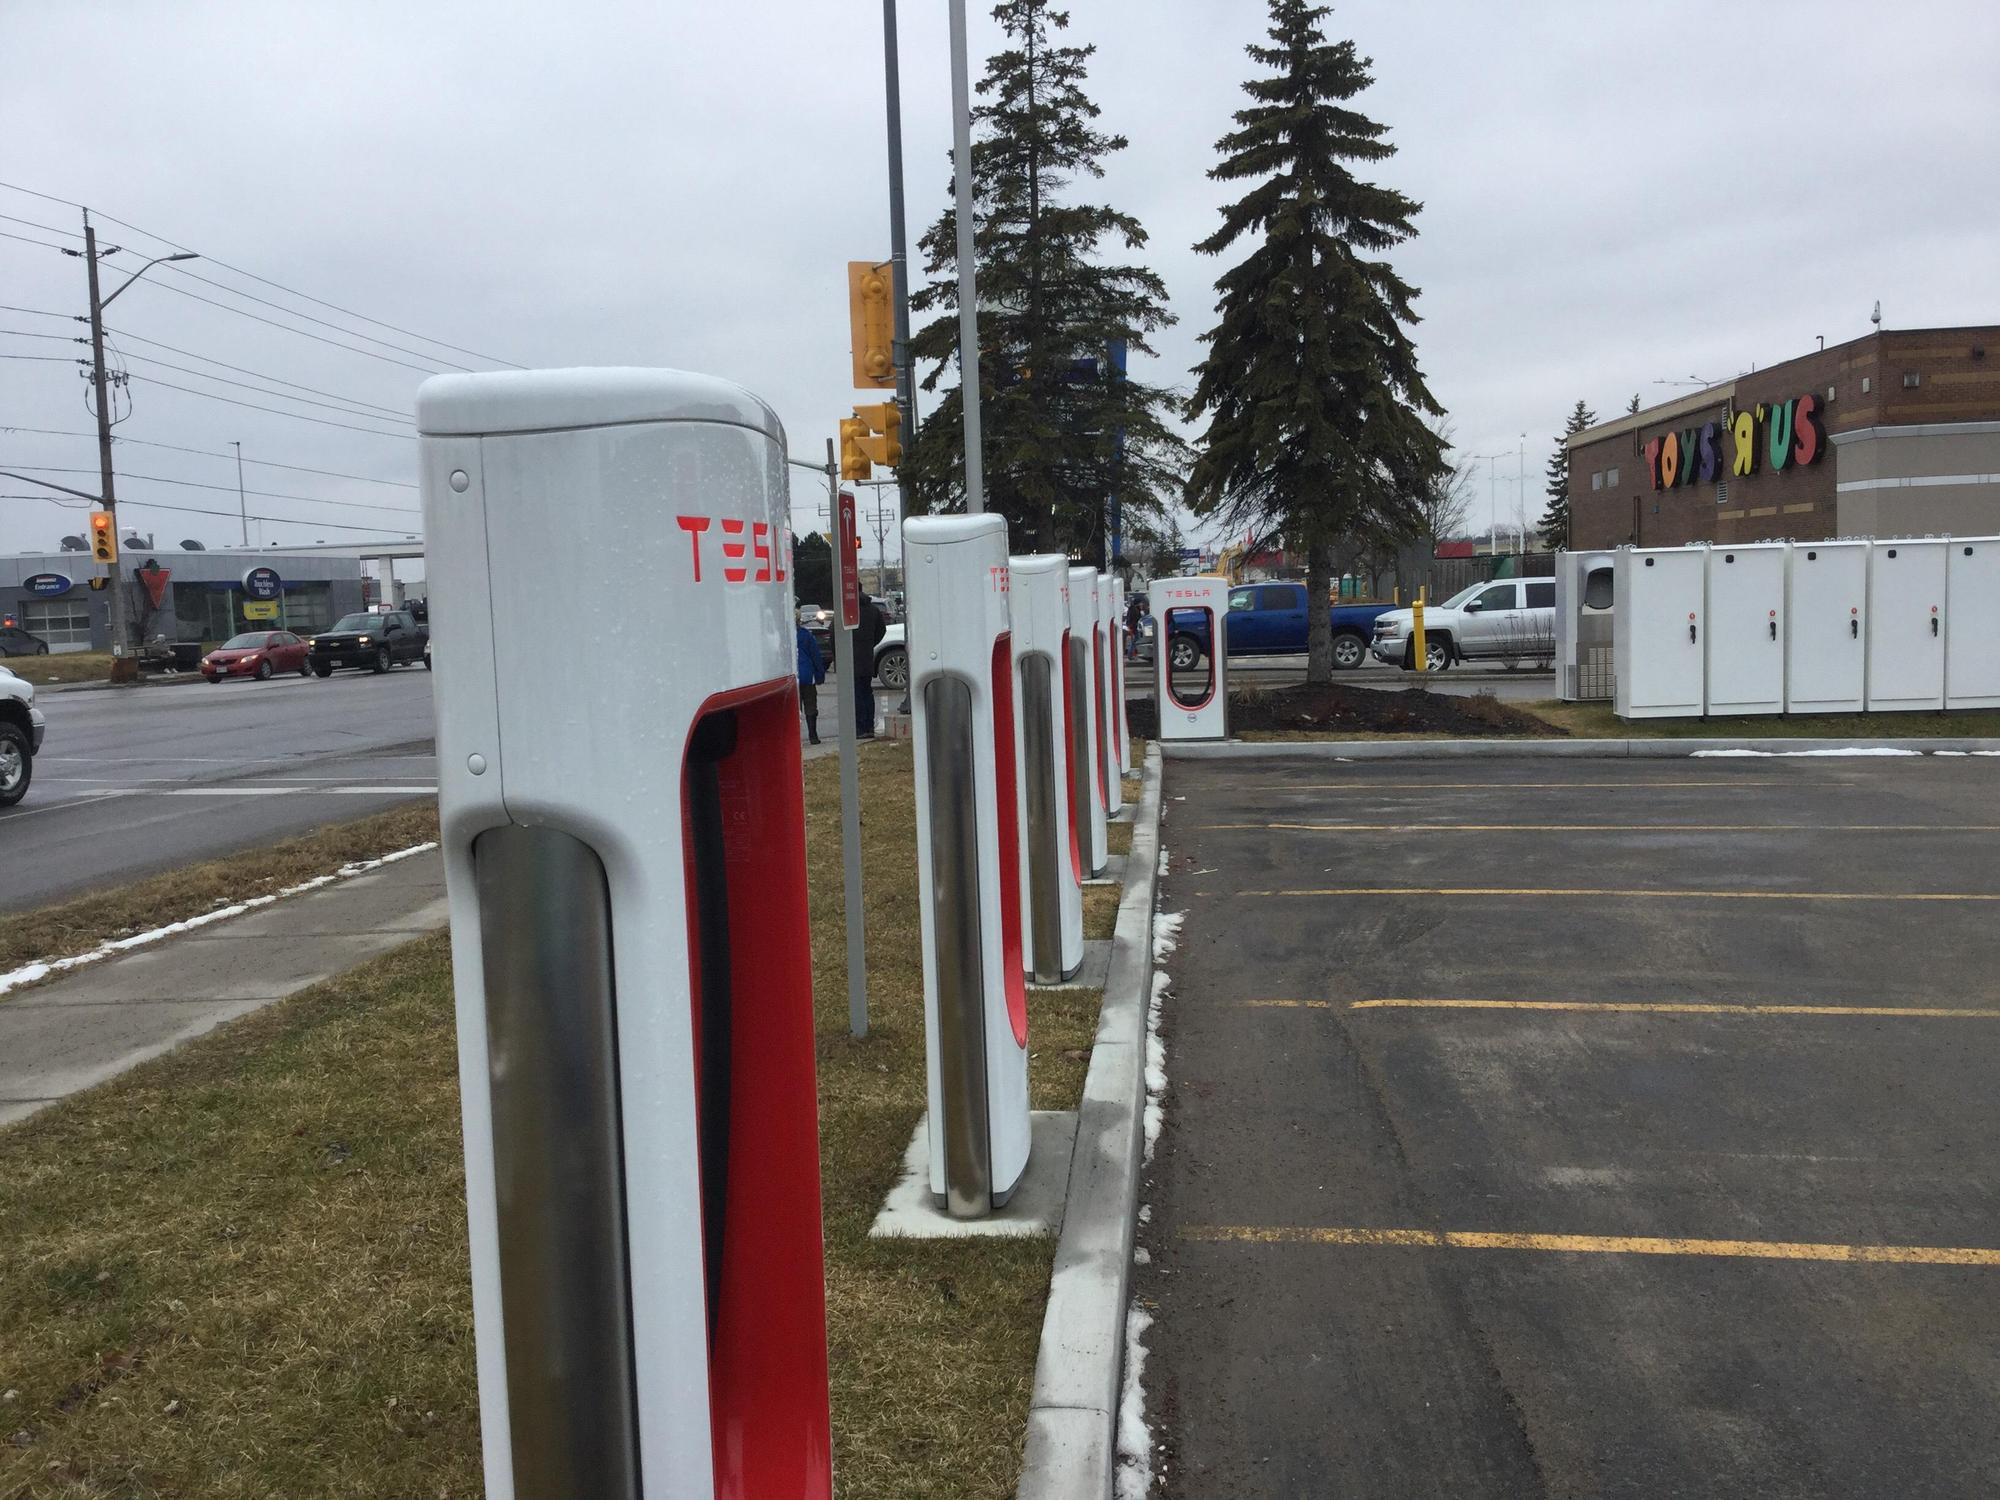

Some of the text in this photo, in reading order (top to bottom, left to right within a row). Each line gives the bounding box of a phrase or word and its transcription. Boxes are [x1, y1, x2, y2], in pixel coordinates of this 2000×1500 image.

[1645, 421, 1717, 490] TOYS
[1770, 394, 1819, 470] US
[1165, 588, 1212, 598] TESLA
